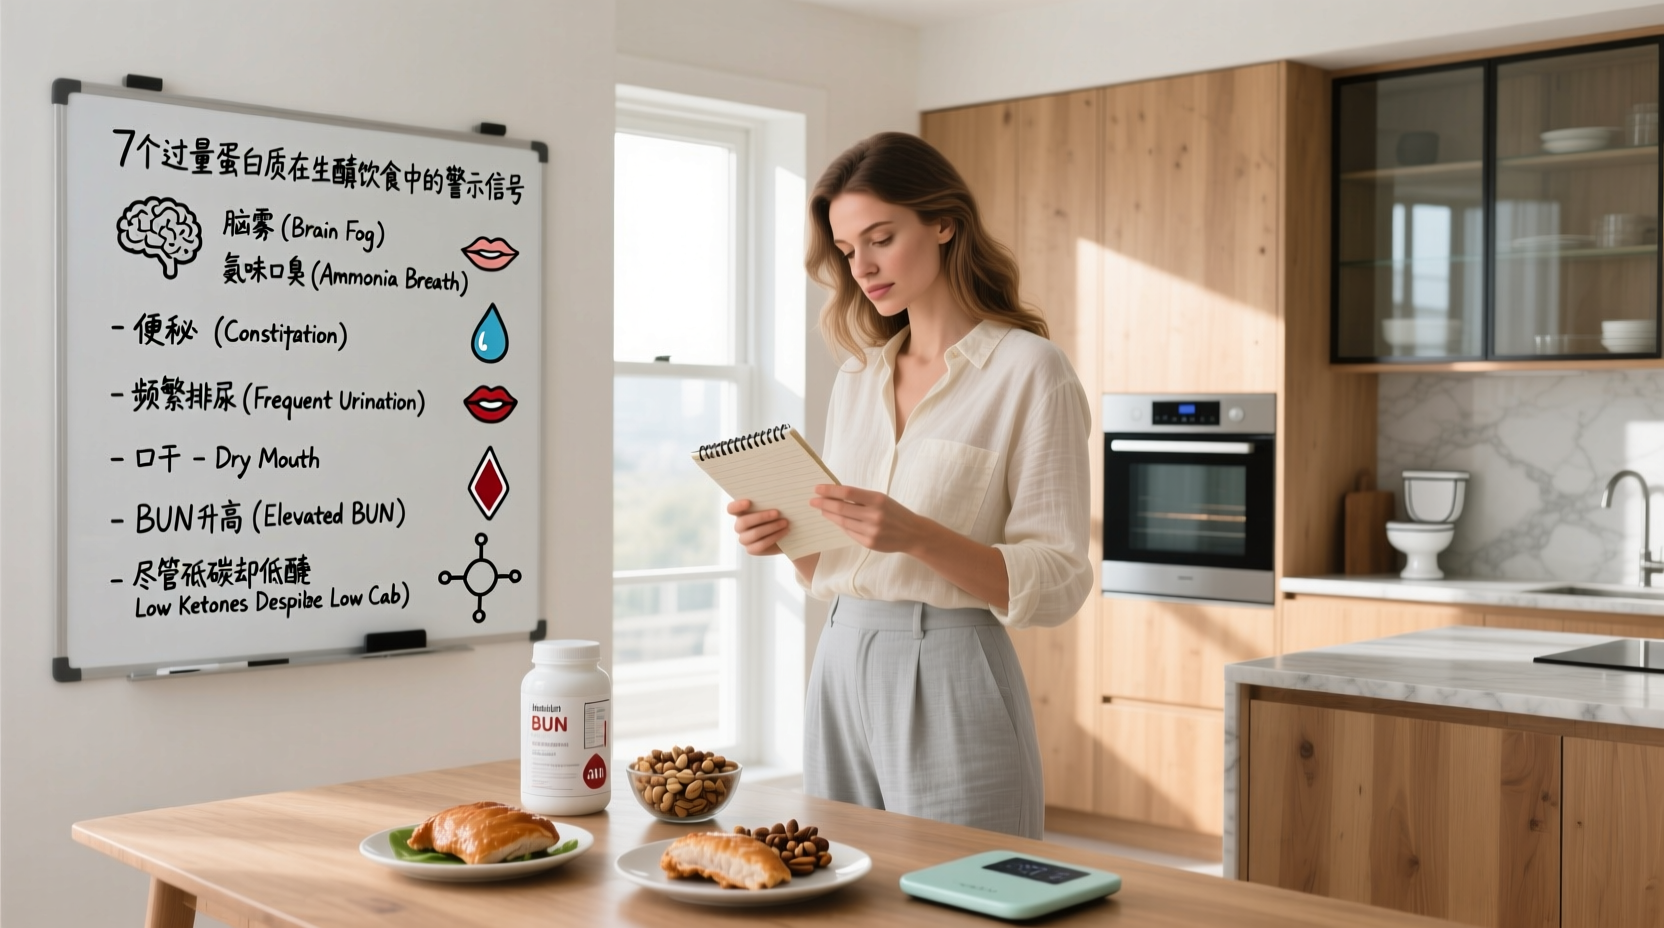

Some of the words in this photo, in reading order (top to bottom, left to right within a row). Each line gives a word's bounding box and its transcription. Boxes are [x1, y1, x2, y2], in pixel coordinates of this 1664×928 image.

[222, 207, 275, 242] 脑雾
[281, 213, 339, 243] (Brain
[345, 219, 386, 254] Fog)
[311, 259, 399, 292] (Ammonia
[405, 266, 470, 298] Breath)
[132, 312, 199, 347] 便秘
[130, 374, 237, 412] 频繁排尿
[242, 382, 334, 421] (Frequent
[339, 389, 426, 418] Urination)
[135, 444, 181, 474] 口干
[215, 445, 252, 480] Dry
[258, 445, 320, 469] Mouth
[136, 499, 243, 535] BUN升高
[252, 499, 344, 535] (Elevated
[351, 497, 407, 529] BUN)
[135, 596, 172, 619] Low
[178, 594, 249, 616] Ketones
[330, 586, 364, 608] Low
[368, 580, 411, 610] Cab)
[531, 715, 568, 732] BUN
